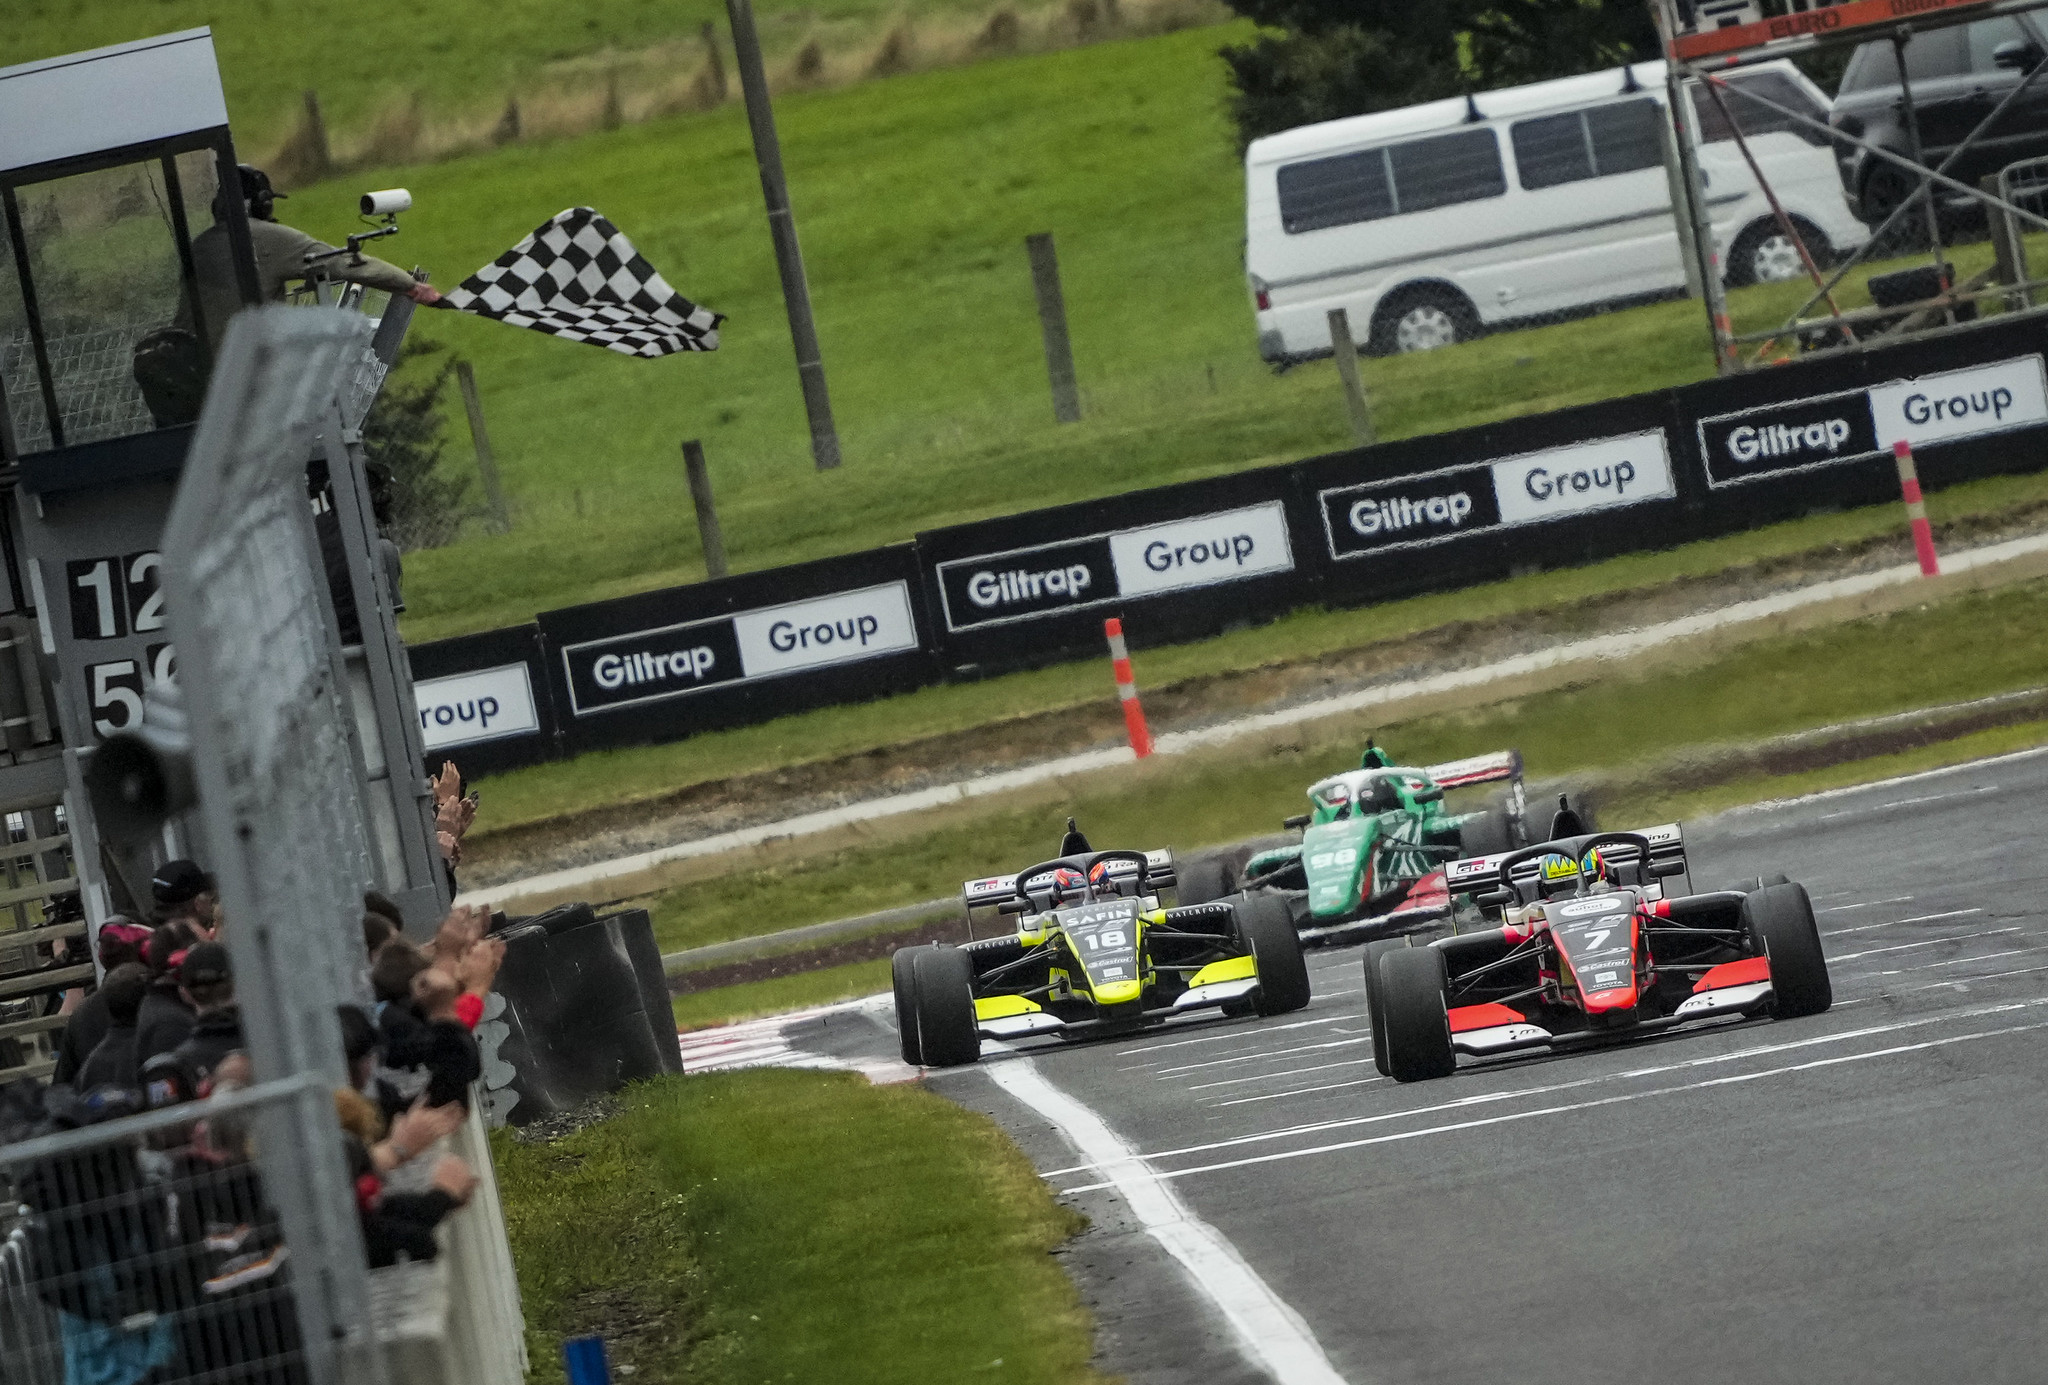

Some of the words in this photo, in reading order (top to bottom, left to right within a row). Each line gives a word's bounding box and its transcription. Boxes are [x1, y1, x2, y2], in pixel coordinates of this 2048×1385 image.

[1727, 416, 1850, 463] Giltrap
[1904, 384, 2013, 425] Group
[1349, 490, 1473, 535] Giltrap
[1524, 458, 1636, 501] Group
[968, 562, 1091, 608] Giltrap
[1144, 532, 1254, 573] Group
[77, 552, 169, 637] 12
[593, 642, 715, 690] Giltrap
[769, 611, 878, 653] Group
[419, 693, 500, 730] roup
[1457, 860, 1485, 874] GR
[1066, 909, 1132, 927] SAFIN
[1166, 906, 1229, 920] WATERFORD
[1084, 931, 1127, 950] 18
[1583, 929, 1611, 951] 7
[1098, 957, 1134, 967] Castrol
[1589, 958, 1630, 970] Castrol
